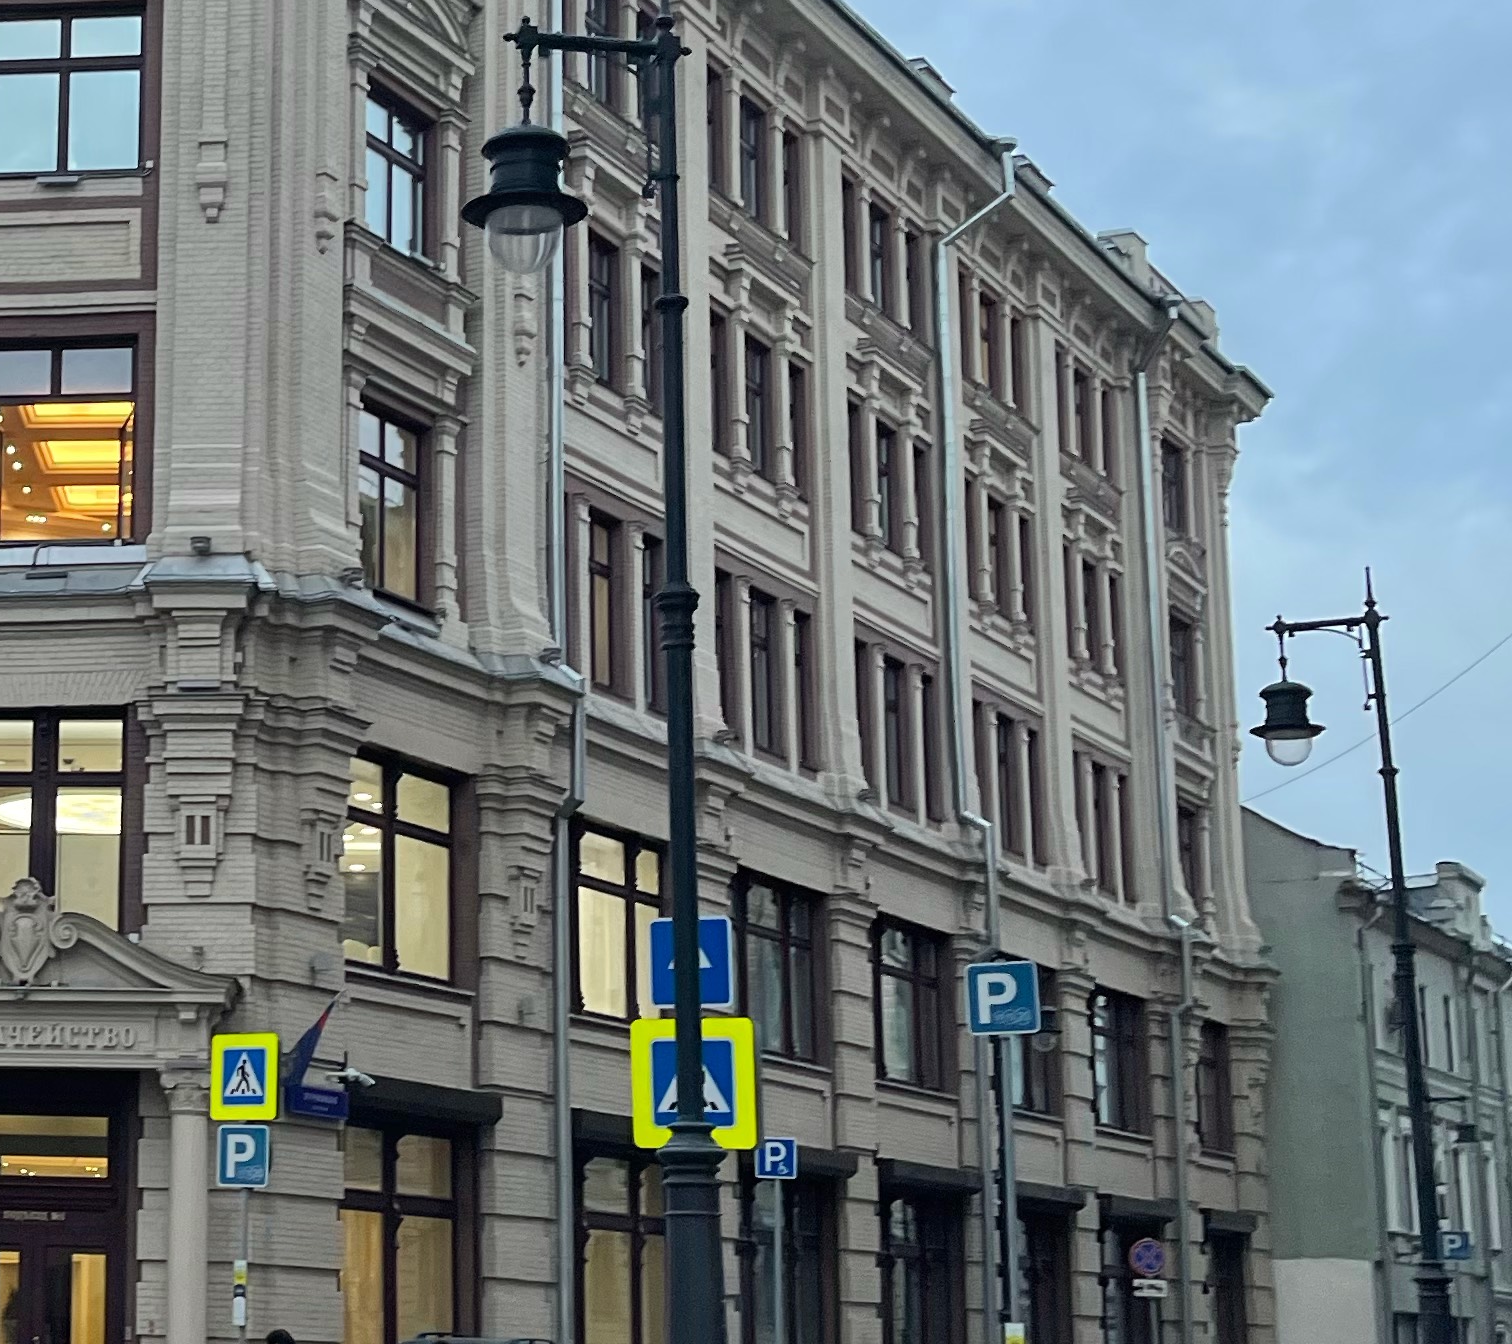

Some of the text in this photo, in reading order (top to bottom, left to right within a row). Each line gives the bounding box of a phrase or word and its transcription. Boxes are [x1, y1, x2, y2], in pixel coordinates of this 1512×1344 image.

[977, 972, 1017, 1024] P
[226, 1133, 256, 1178] P
[764, 1141, 787, 1172] P
[1442, 1234, 1462, 1257] P
